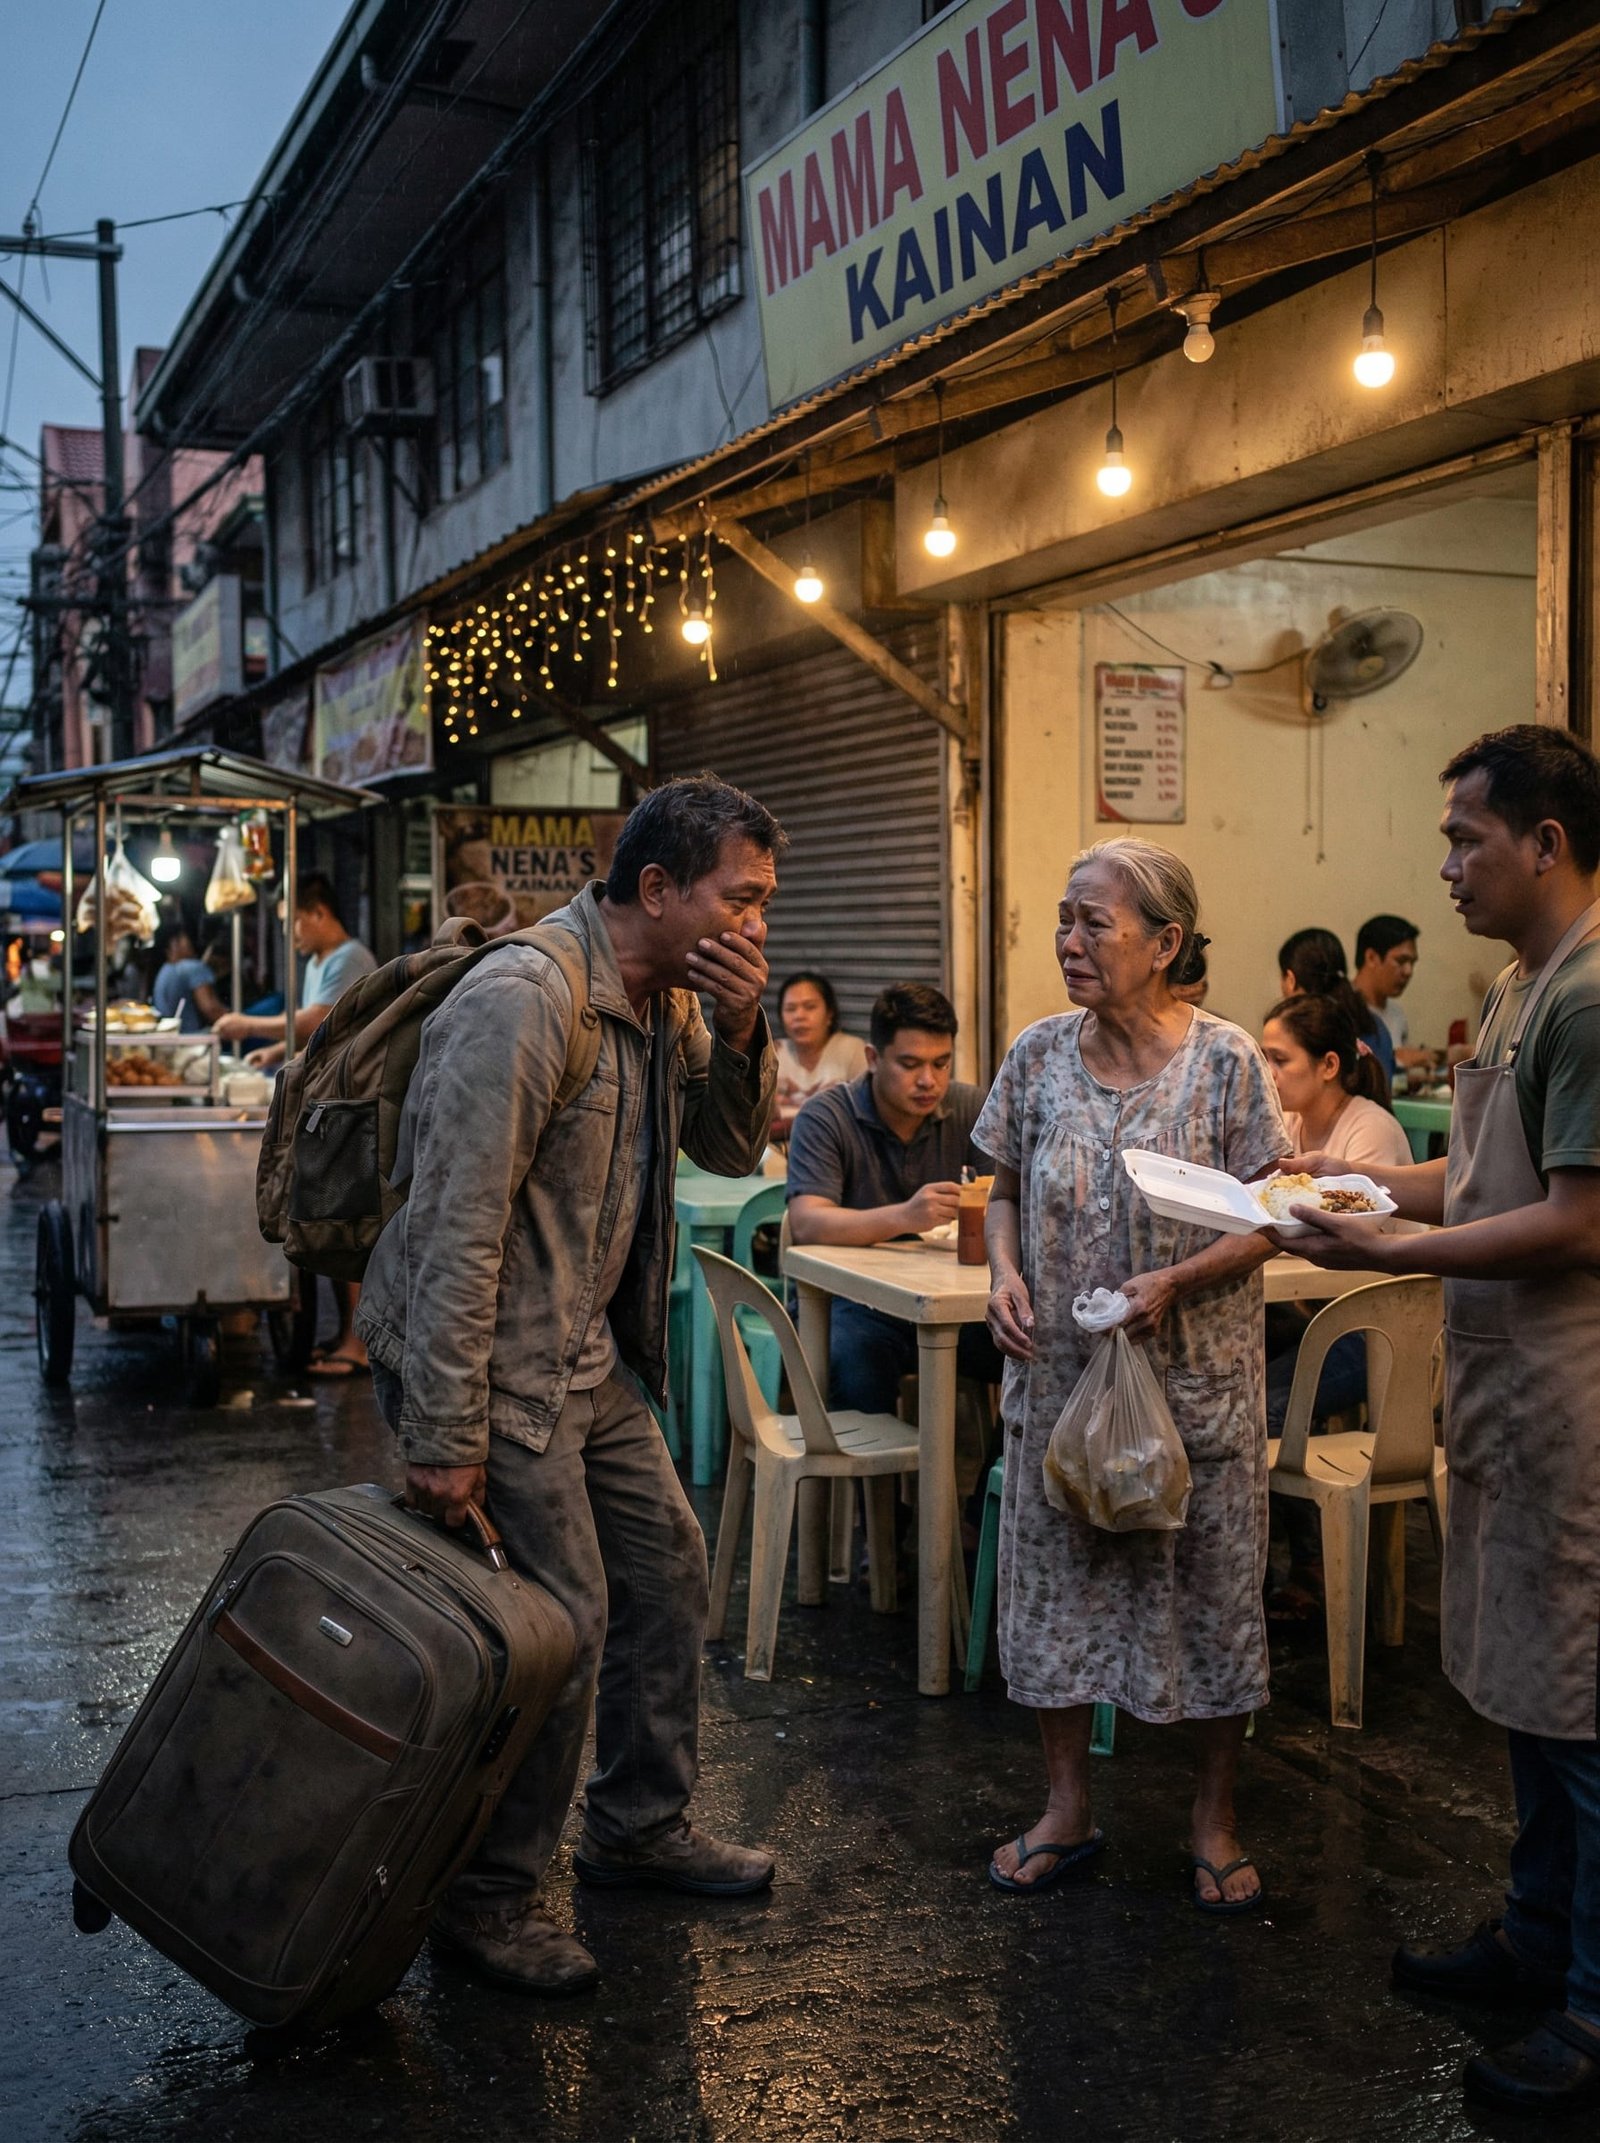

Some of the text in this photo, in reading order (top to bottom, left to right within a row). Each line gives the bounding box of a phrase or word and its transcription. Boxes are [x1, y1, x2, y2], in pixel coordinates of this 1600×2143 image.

[757, 0, 1223, 297] MAMA NENA
[845, 98, 1126, 345] KAINAN
[491, 815, 596, 847] MAMA
[491, 850, 596, 876] NENA'S
[504, 878, 579, 892] KAINAN
